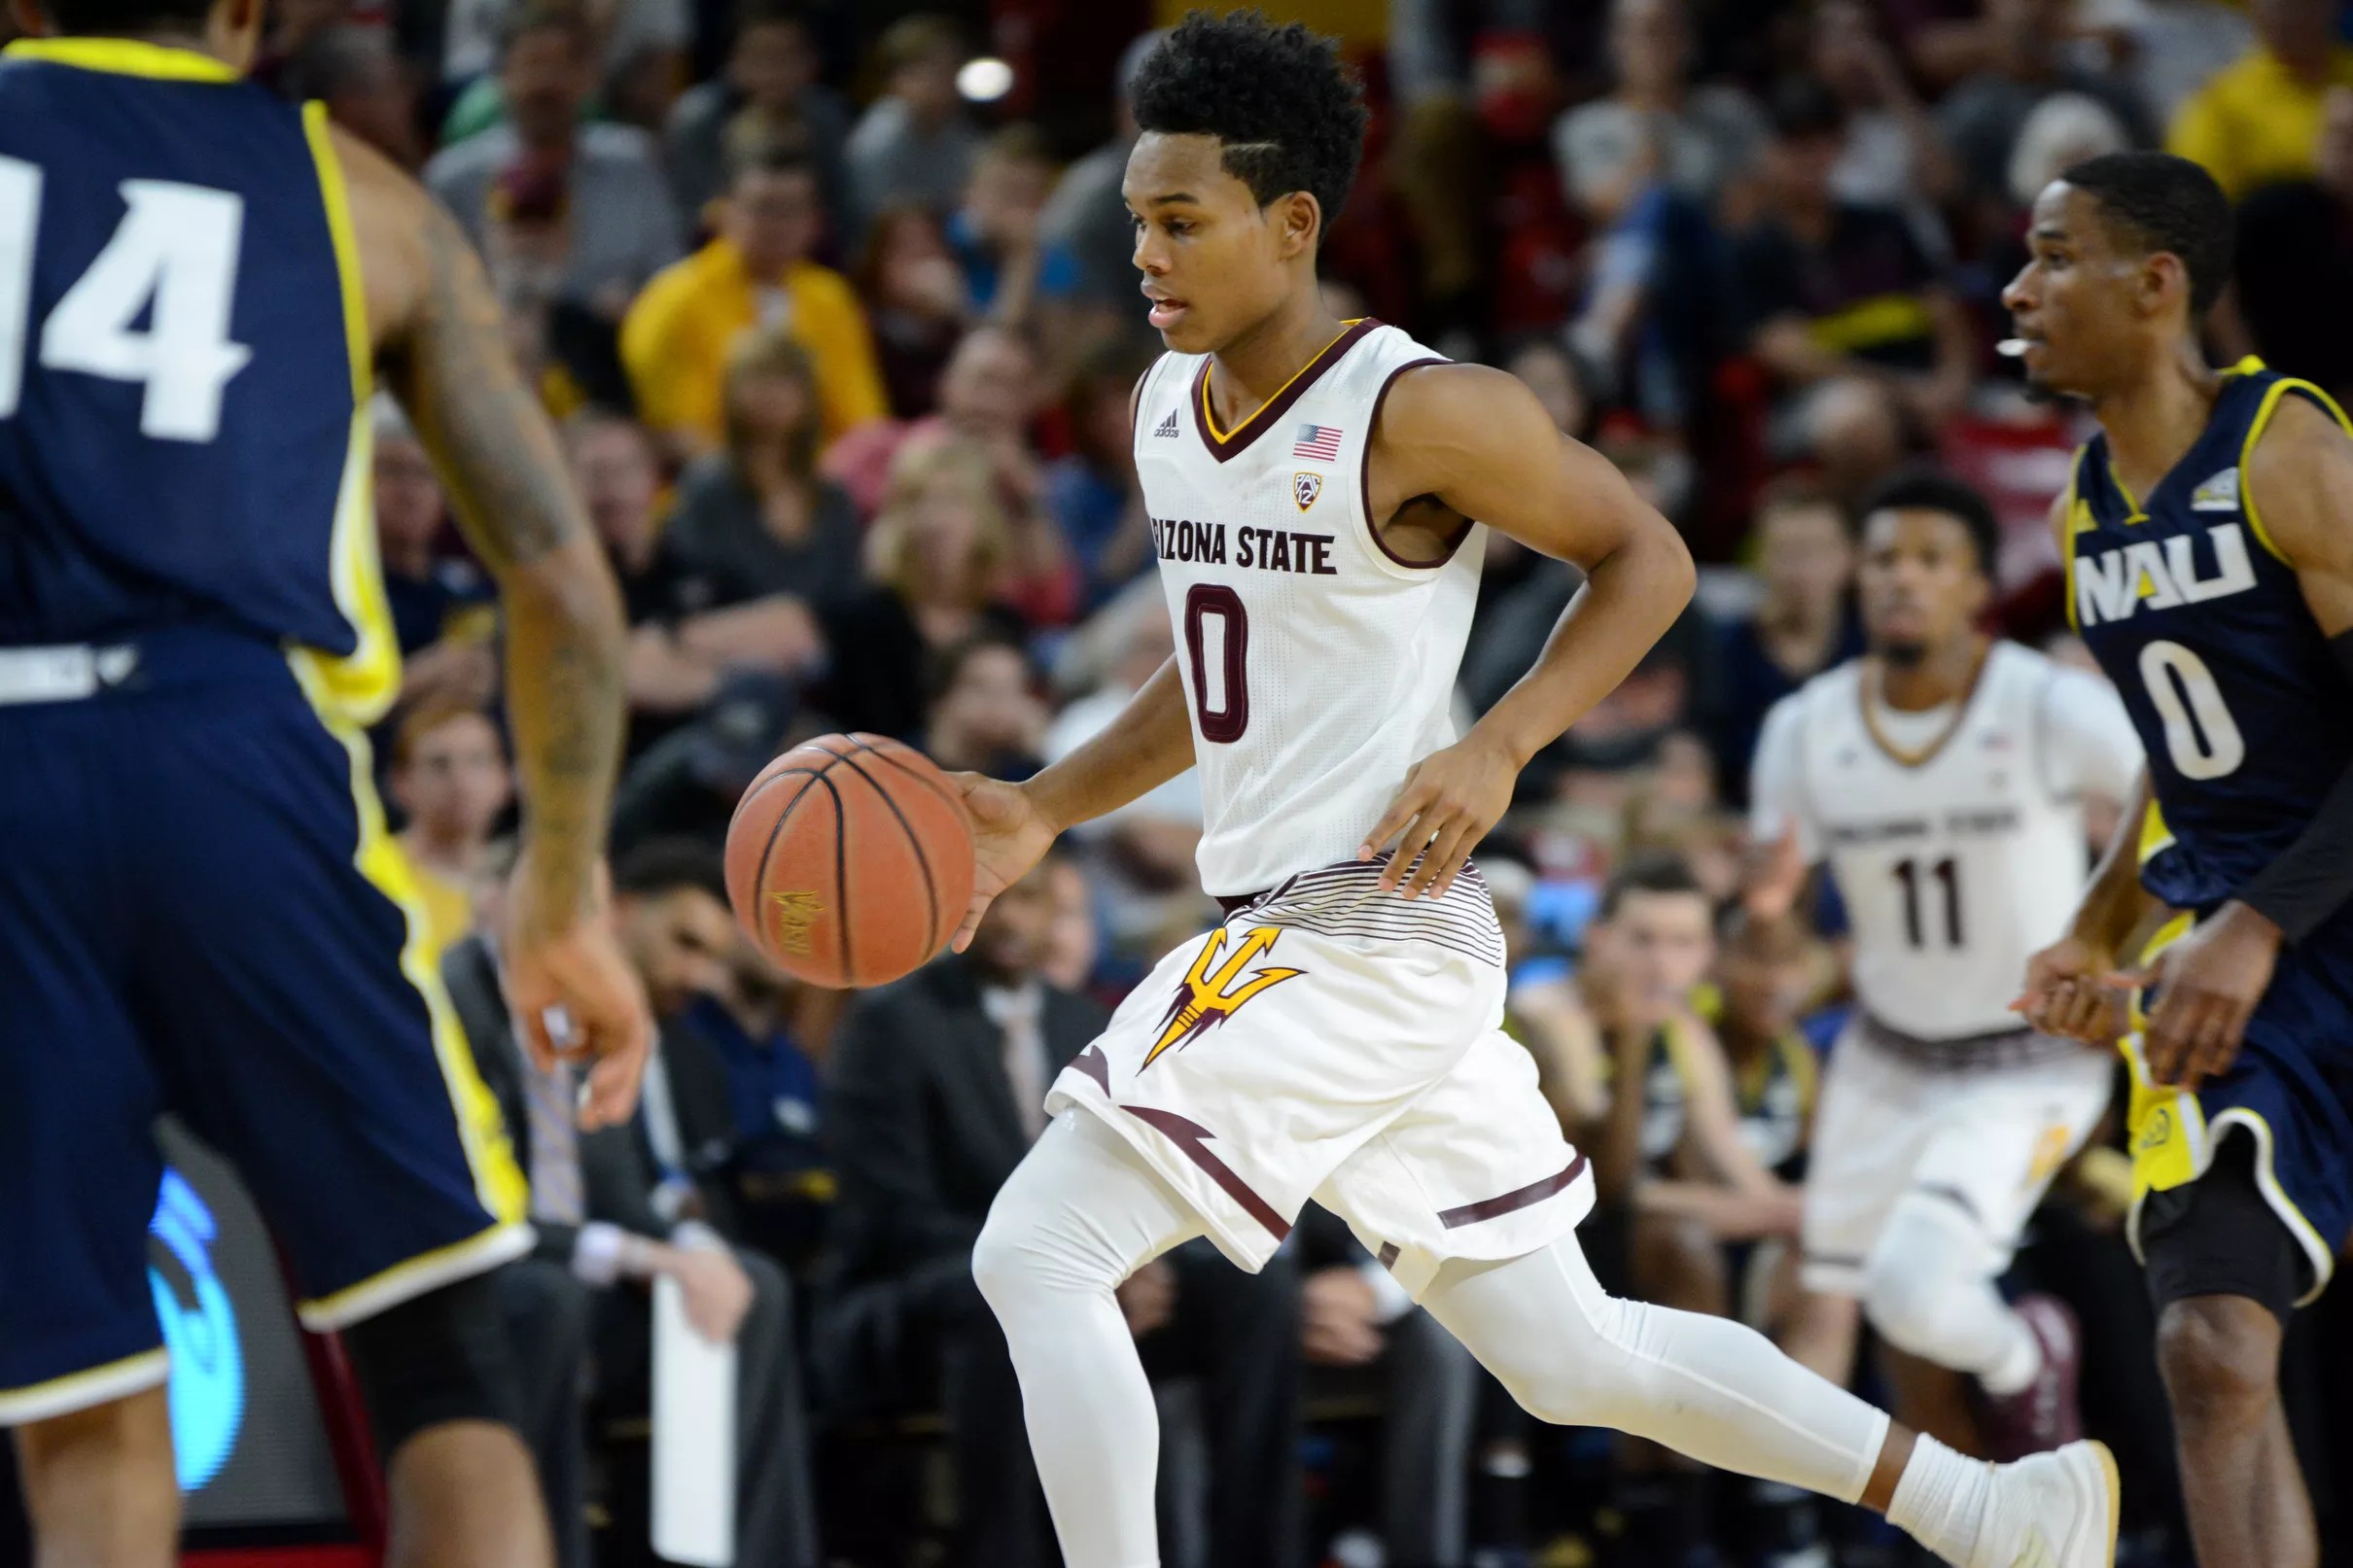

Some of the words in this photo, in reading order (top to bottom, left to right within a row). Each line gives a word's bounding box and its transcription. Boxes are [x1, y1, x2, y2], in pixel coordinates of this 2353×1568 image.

[1153, 426, 1179, 438] adidas
[1295, 473, 1320, 497] PAC
[1298, 489, 1312, 505] 12
[1236, 525, 1338, 575] STATE
[2074, 522, 2258, 626] NAU
[1184, 582, 1249, 744] 0
[2139, 640, 2246, 780] 0
[1892, 856, 1963, 948] 11
